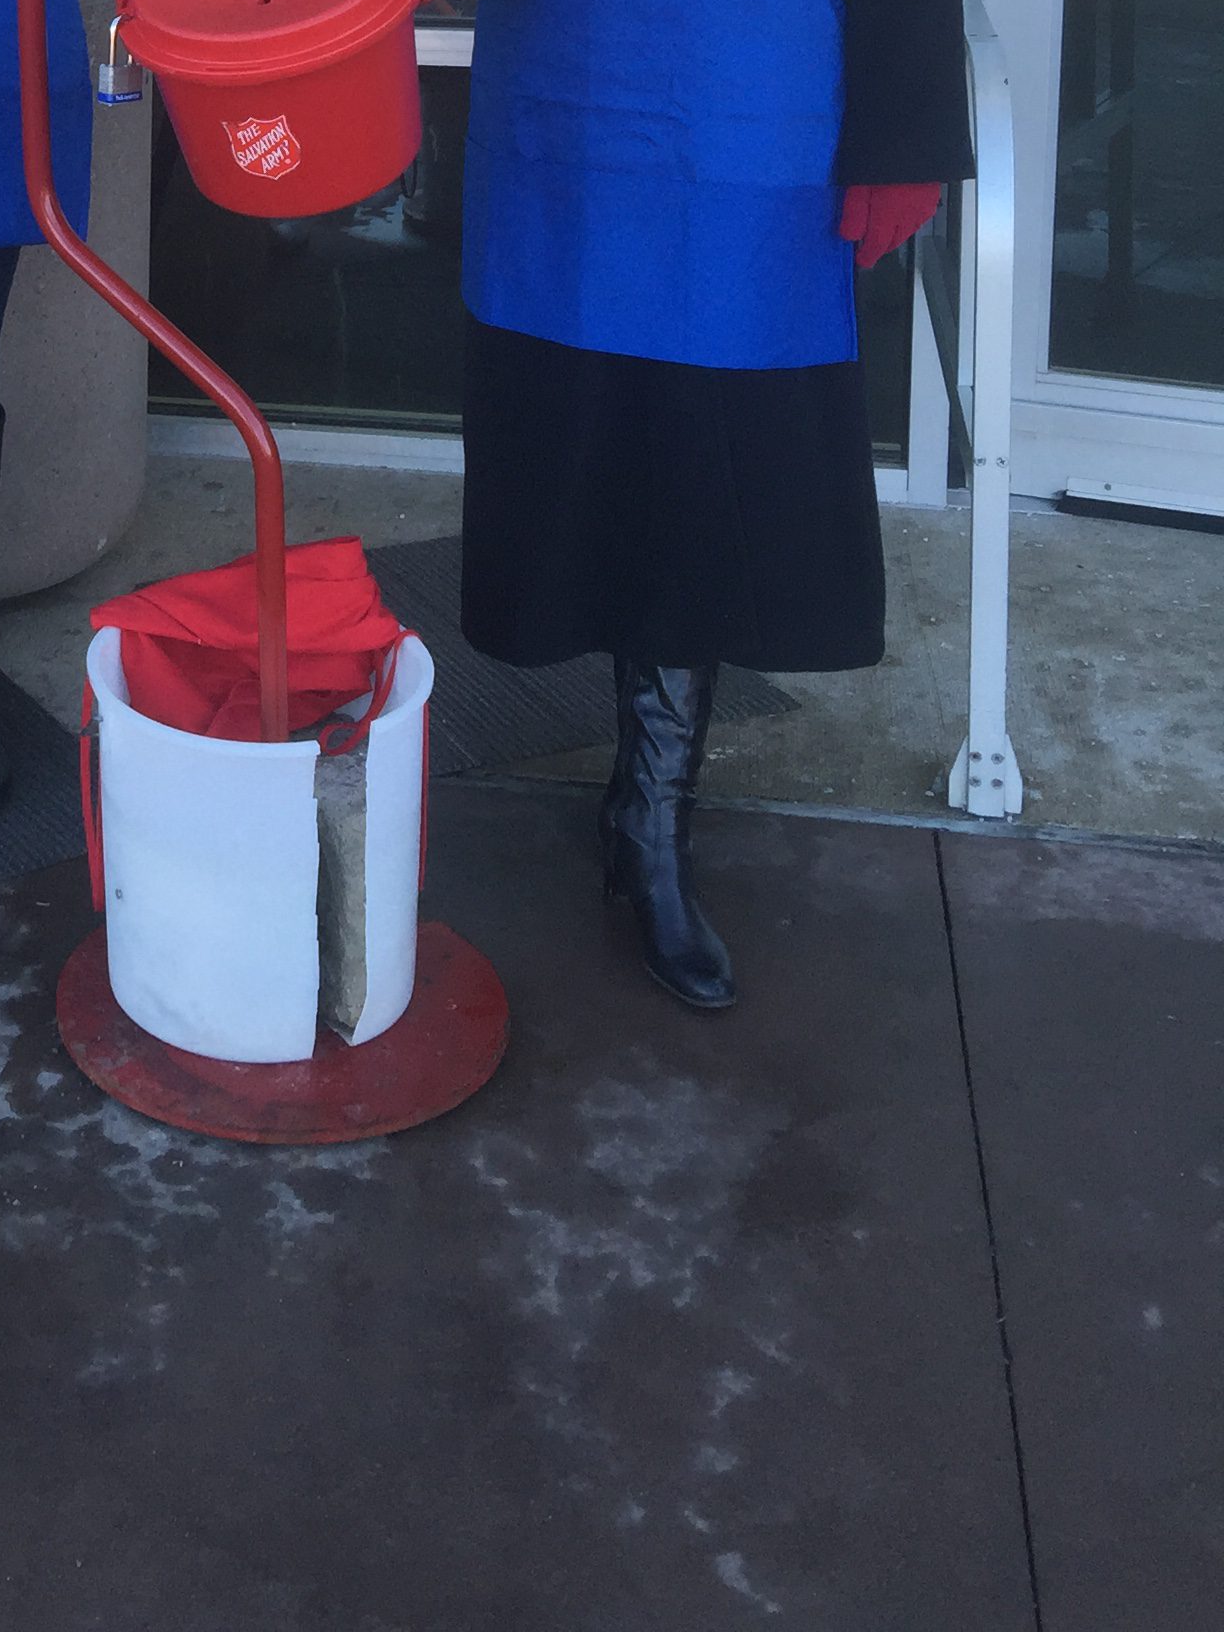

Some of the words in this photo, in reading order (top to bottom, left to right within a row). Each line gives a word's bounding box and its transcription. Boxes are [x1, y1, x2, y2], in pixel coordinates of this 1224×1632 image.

[236, 123, 262, 146] THE
[236, 121, 287, 167] SALVATION
[261, 139, 290, 174] ARMY
